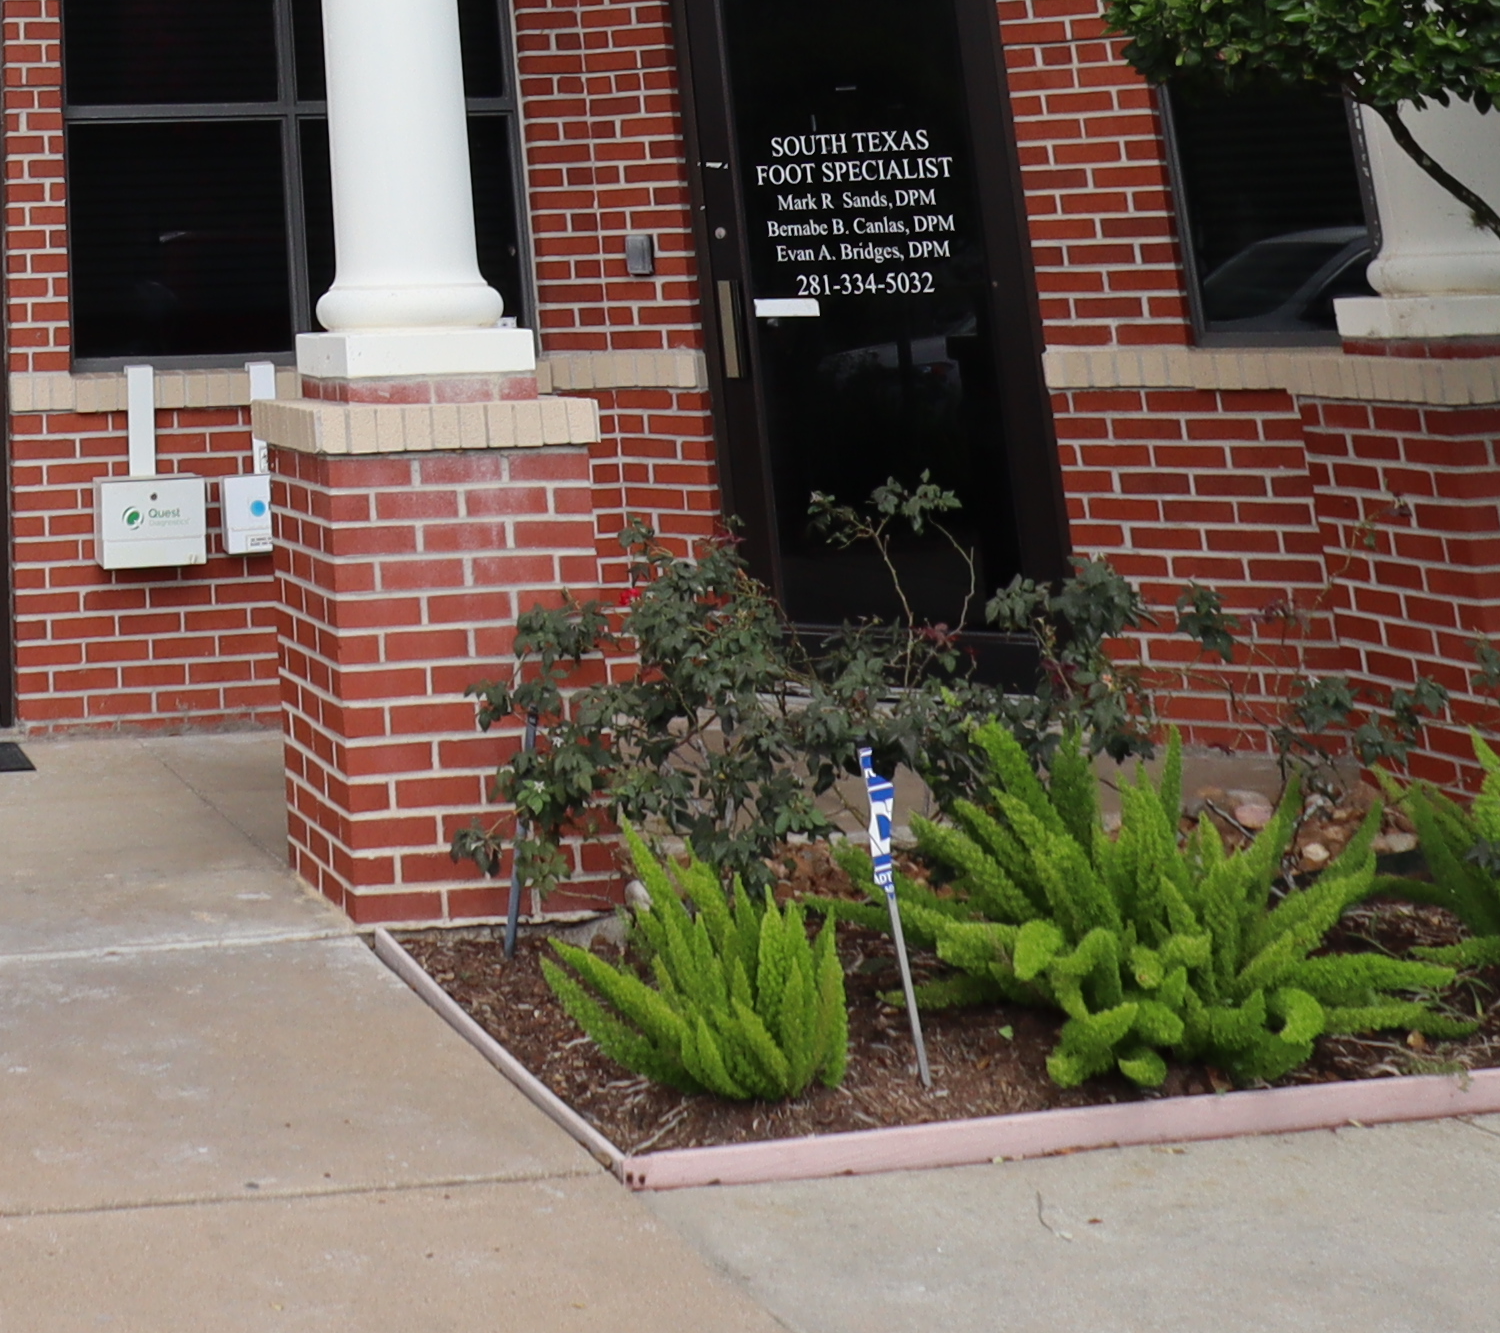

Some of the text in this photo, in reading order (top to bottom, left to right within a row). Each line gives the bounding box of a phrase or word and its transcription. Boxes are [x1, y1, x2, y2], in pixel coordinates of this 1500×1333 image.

[770, 129, 930, 157] SOUTH TEXAS
[755, 156, 953, 186] FOOT SPECIALIST
[777, 193, 818, 211] Mark
[894, 188, 937, 207] DPM
[766, 214, 956, 238] Bernabe B. Canlas, DPM
[775, 240, 951, 264] Evan A. Bridges, DPM
[796, 271, 936, 296] 281-334-5032
[148, 507, 181, 519] Quest
